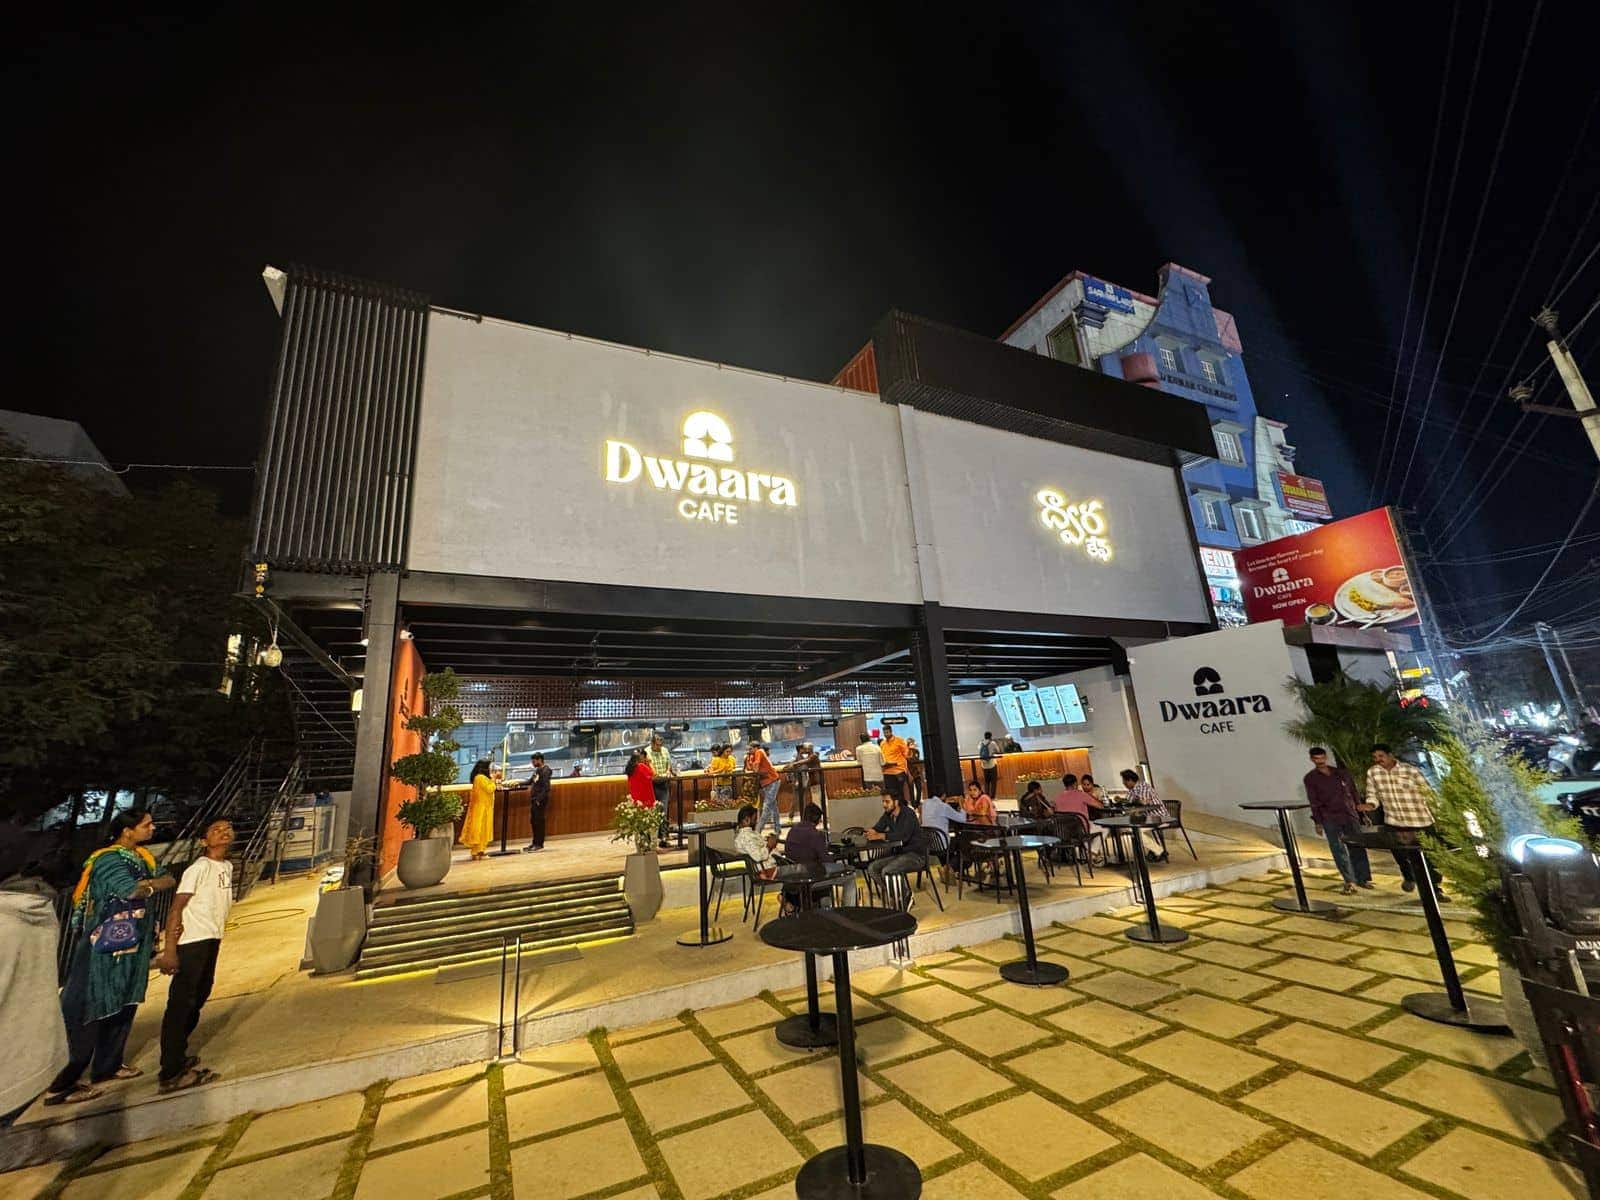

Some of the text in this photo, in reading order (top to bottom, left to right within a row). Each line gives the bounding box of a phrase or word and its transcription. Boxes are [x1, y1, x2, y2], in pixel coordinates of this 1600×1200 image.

[605, 439, 798, 507] Dwaara
[677, 500, 739, 525] CAFE
[1253, 577, 1314, 598] Dwaara
[1271, 598, 1307, 609] NOW OPEN
[1159, 694, 1272, 722] Dwaara
[1200, 721, 1235, 734] CAFE
